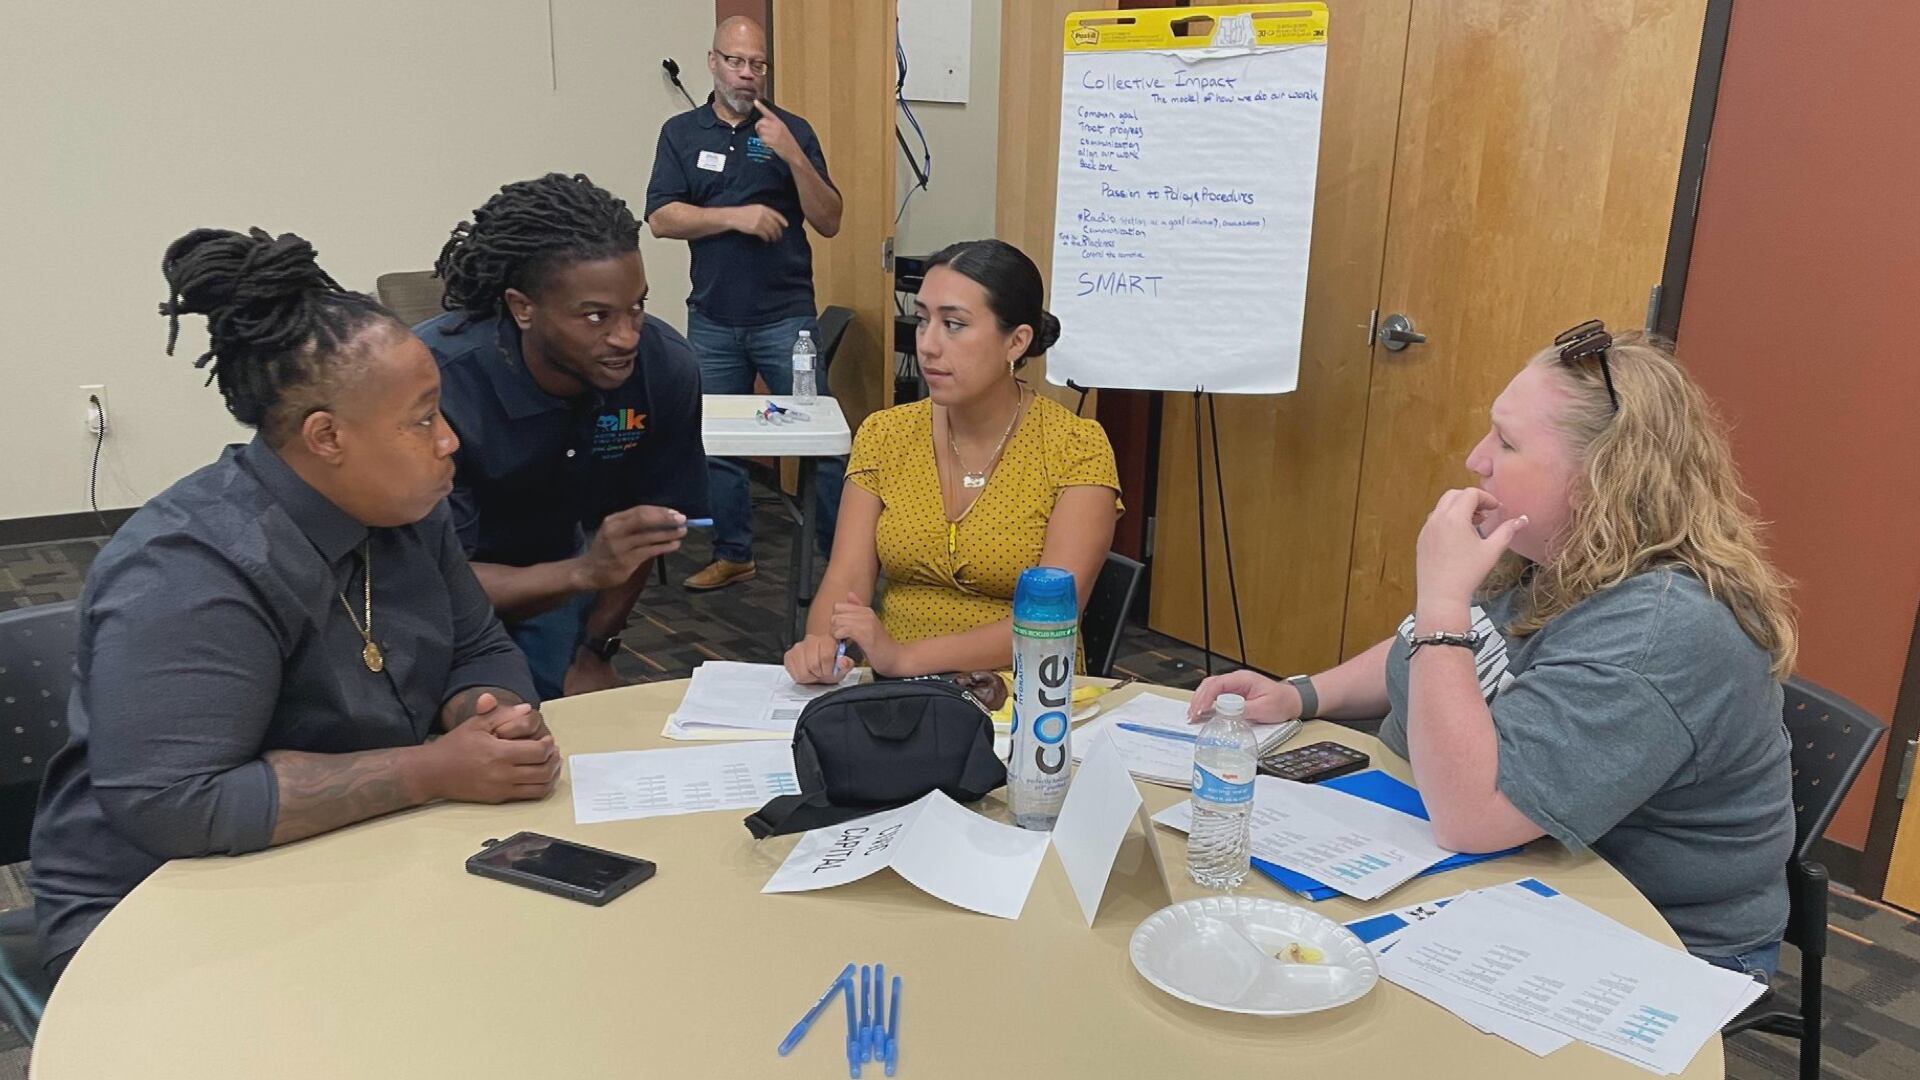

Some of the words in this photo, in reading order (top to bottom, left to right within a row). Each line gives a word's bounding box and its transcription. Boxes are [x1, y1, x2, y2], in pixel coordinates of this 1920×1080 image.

[1083, 70, 1165, 90] Collective
[1174, 69, 1237, 90] Impact
[1151, 93, 1166, 104] The
[1171, 93, 1199, 104] model
[1203, 92, 1214, 102] of
[1216, 93, 1234, 102] how
[1254, 90, 1267, 100] do
[1271, 92, 1285, 100] our
[1119, 108, 1138, 124] goal
[1101, 182, 1140, 198] Passion
[1147, 189, 1160, 199] to
[1083, 208, 1116, 223] Radio
[1077, 271, 1163, 297] SMART
[1032, 654, 1069, 776] core
[812, 826, 870, 874] CAPITAL
